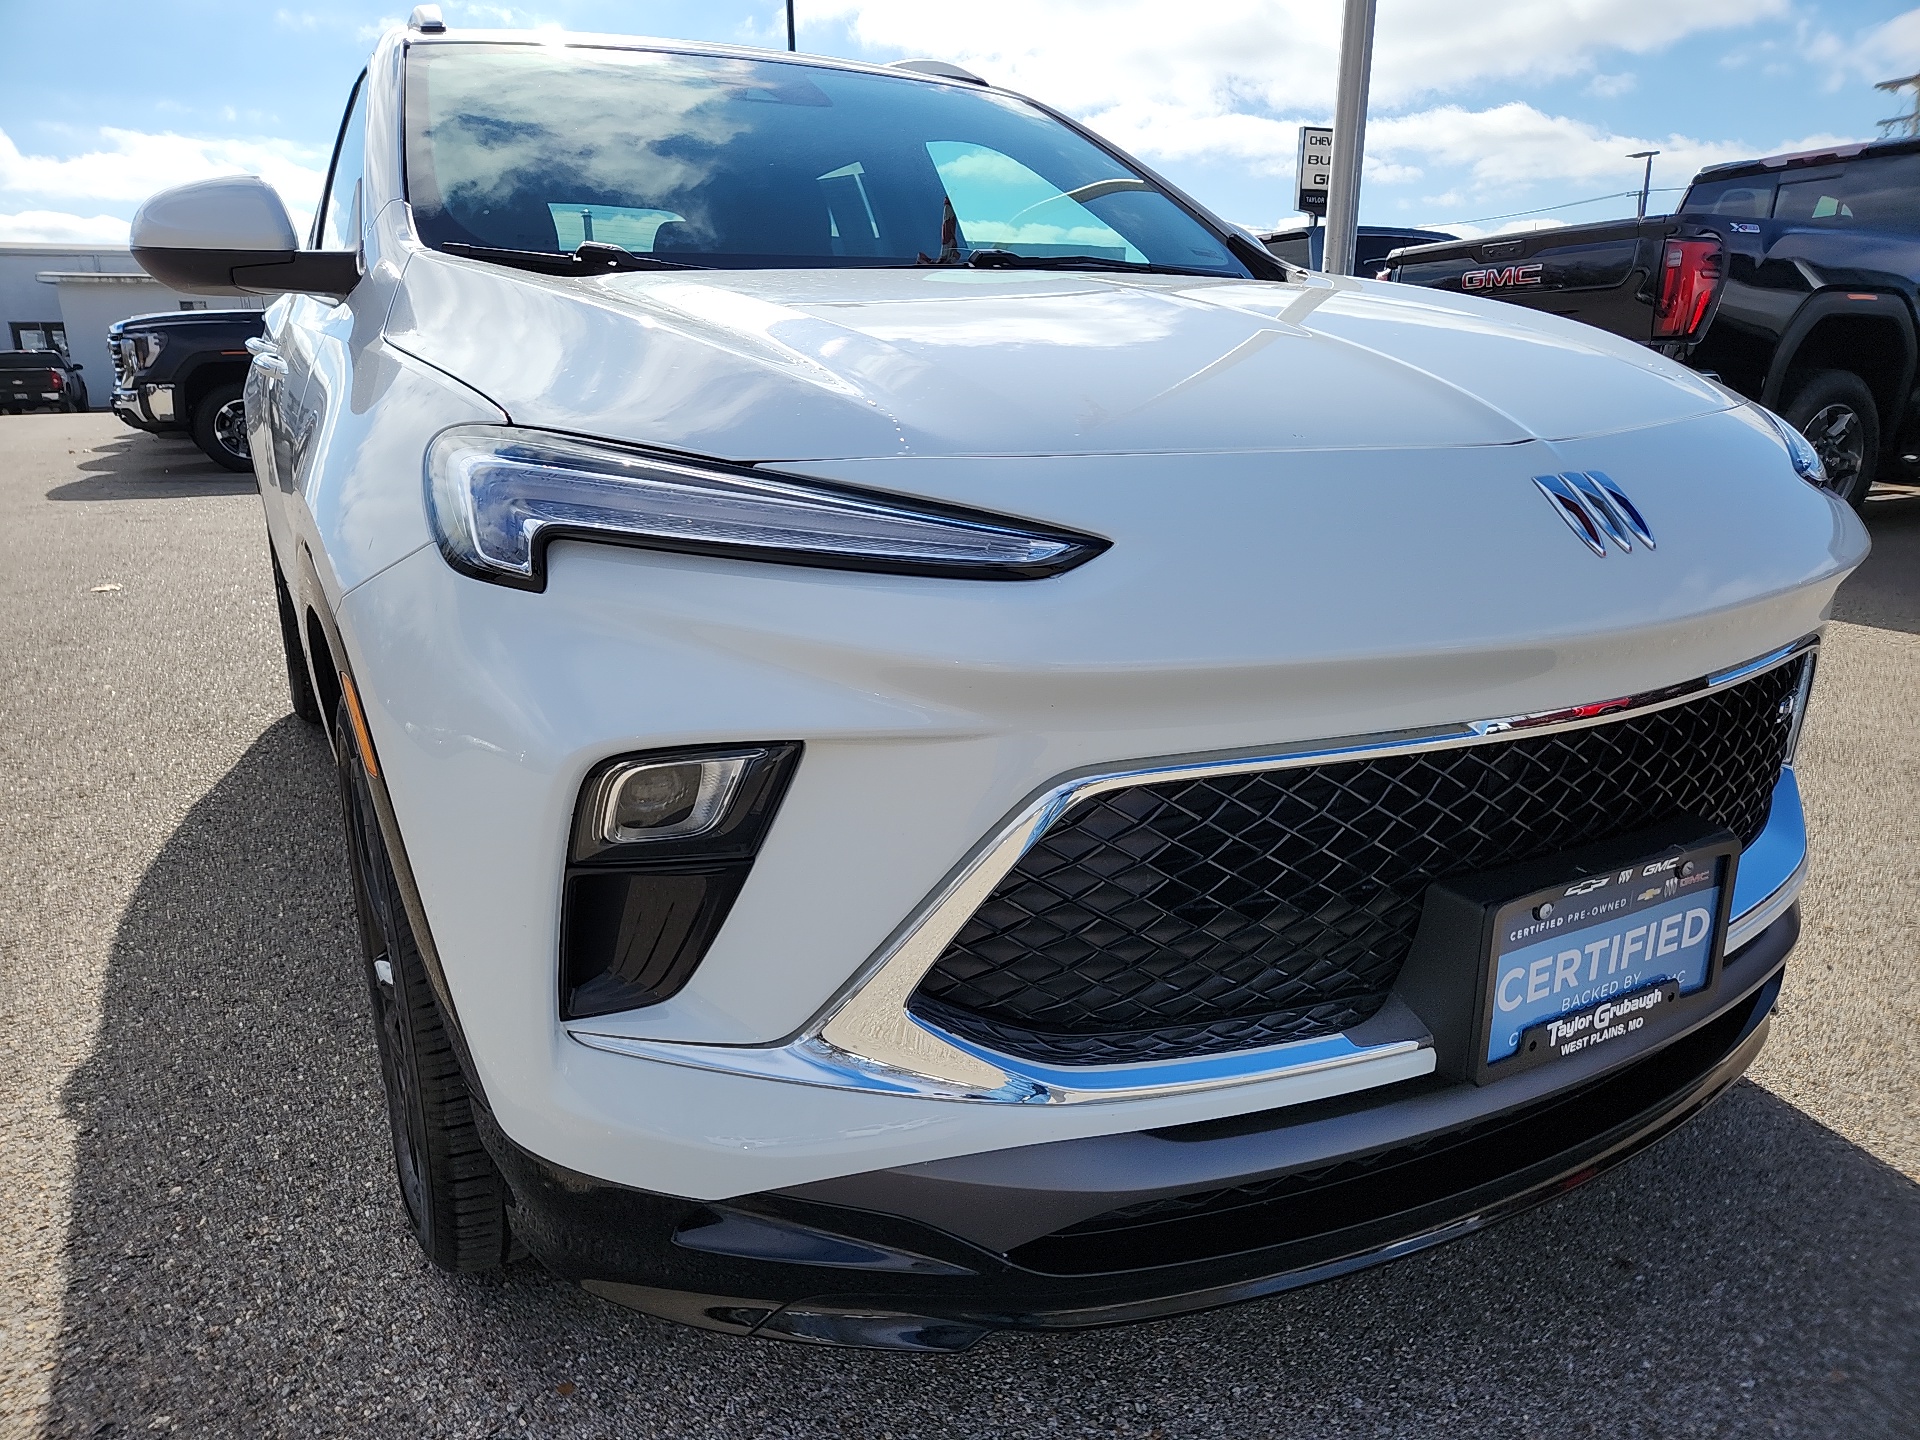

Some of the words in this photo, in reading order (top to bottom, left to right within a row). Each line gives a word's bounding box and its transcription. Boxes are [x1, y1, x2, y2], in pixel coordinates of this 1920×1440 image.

[1462, 263, 1543, 290] GMC
[1642, 856, 1680, 877] GMC
[1680, 870, 1710, 888] GMC
[1509, 916, 1564, 942] CERTIFIED
[1567, 898, 1627, 924] PRE-OWNED
[1497, 907, 1711, 1013] CERTIFIED
[1561, 981, 1619, 1012] BACKED
[1624, 971, 1641, 989] BY
[1547, 1014, 1592, 1047] Taylor
[1594, 988, 1662, 1030] Grubaugh
[1560, 1035, 1590, 1056] WEST
[1590, 1023, 1626, 1046] PLAINS,
[1628, 1016, 1644, 1033] MO
